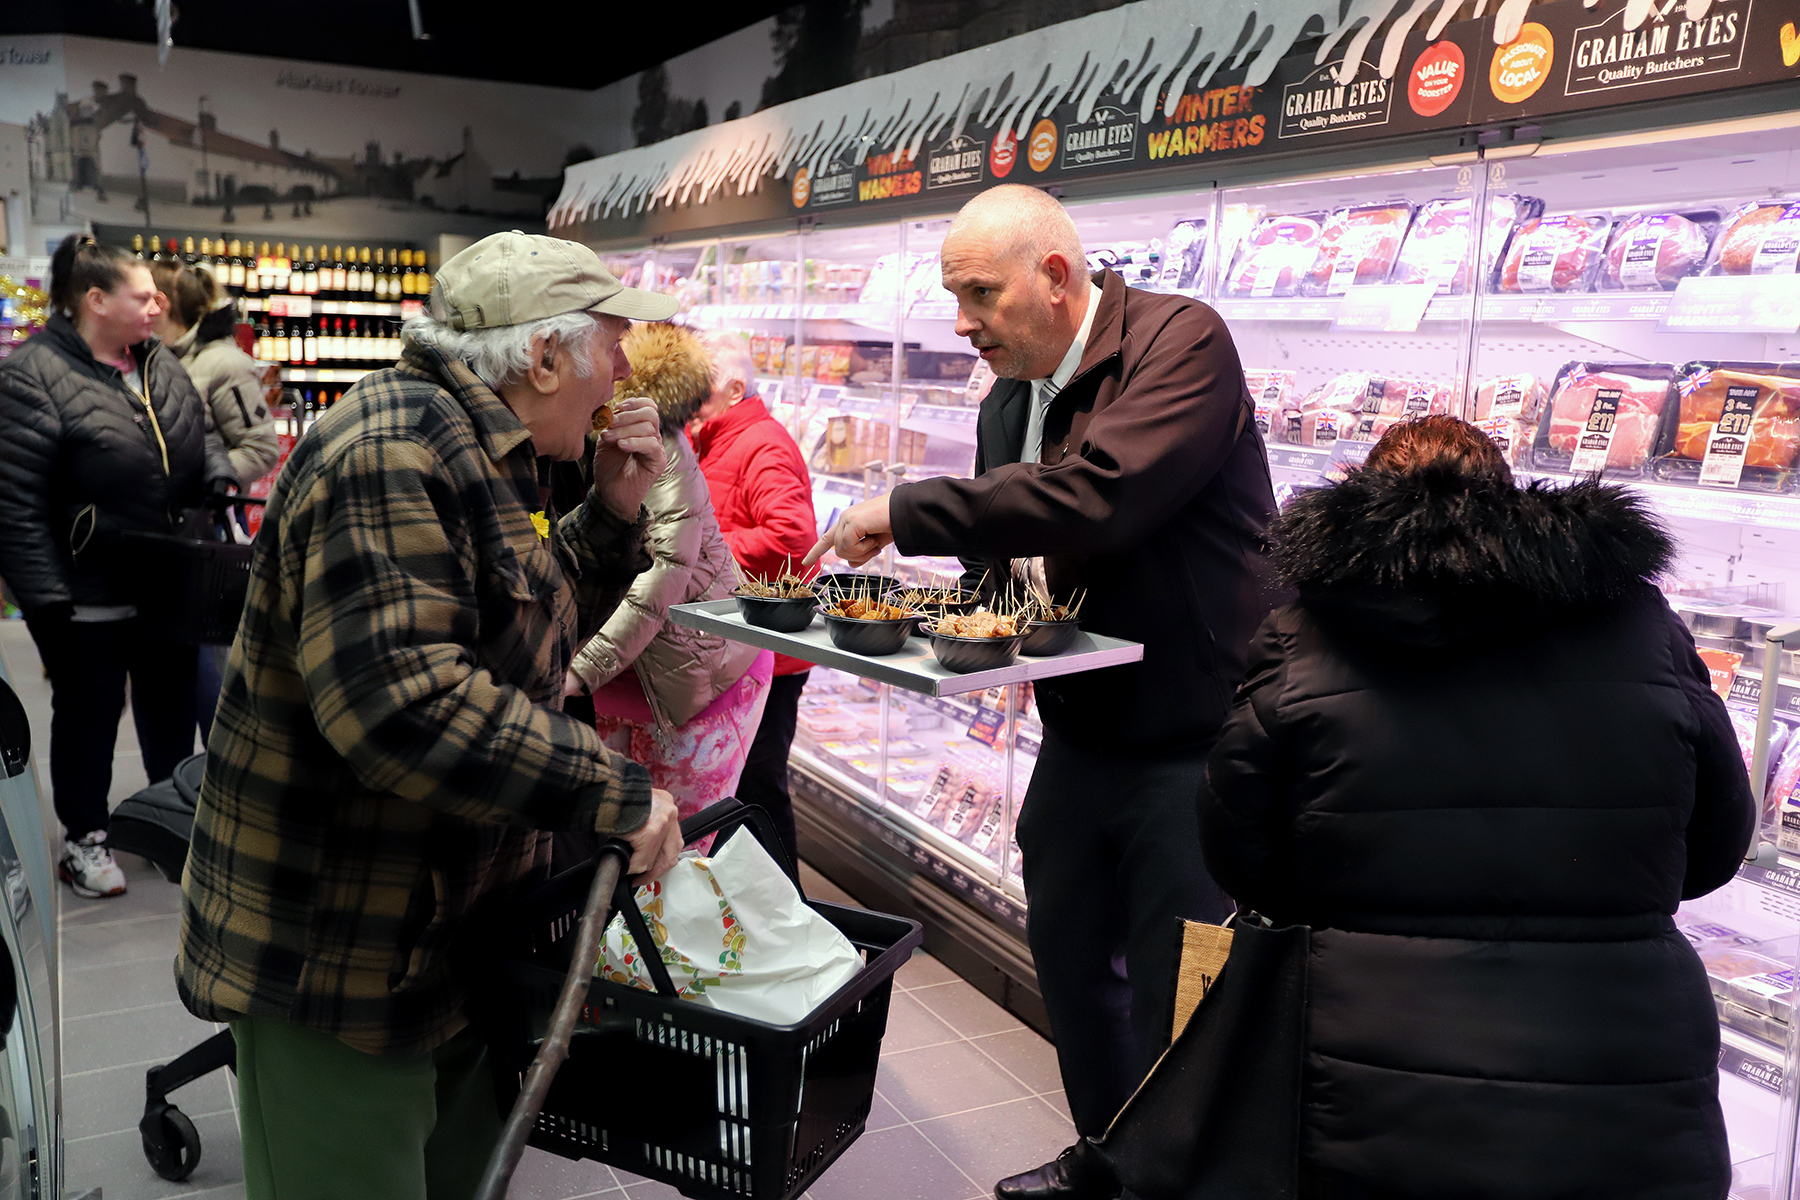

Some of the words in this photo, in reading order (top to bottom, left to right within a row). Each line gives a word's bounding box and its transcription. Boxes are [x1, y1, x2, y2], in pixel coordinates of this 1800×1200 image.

[1576, 25, 1671, 69] GRAHAM
[1675, 12, 1739, 52] EYES
[1499, 42, 1548, 67] PASSIONATE
[1509, 57, 1534, 69] ABOUT
[1417, 60, 1460, 81] VALUE
[1499, 67, 1541, 87] LOCAL
[1597, 64, 1644, 84] Quality
[1645, 54, 1705, 76] Butchers
[1286, 86, 1346, 118] GRAHAM
[1348, 79, 1387, 107] EYES
[1417, 83, 1454, 98] DOORSTEP
[1299, 115, 1330, 131] Quality
[1329, 110, 1368, 125] Butchers
[1066, 127, 1107, 152] GRAHAM
[1107, 123, 1135, 146] EYES
[1147, 114, 1266, 160] WARMERS
[1363, 395, 1383, 413] £11
[1594, 399, 1603, 411] 3
[1725, 399, 1735, 411] 3
[1588, 412, 1615, 432] £11
[1719, 412, 1750, 433] £11
[1732, 684, 1751, 696] AHAM
[1765, 870, 1795, 887] GRAHAM
[1741, 1062, 1773, 1081] GRAHAM
[1771, 1075, 1783, 1086] EY
